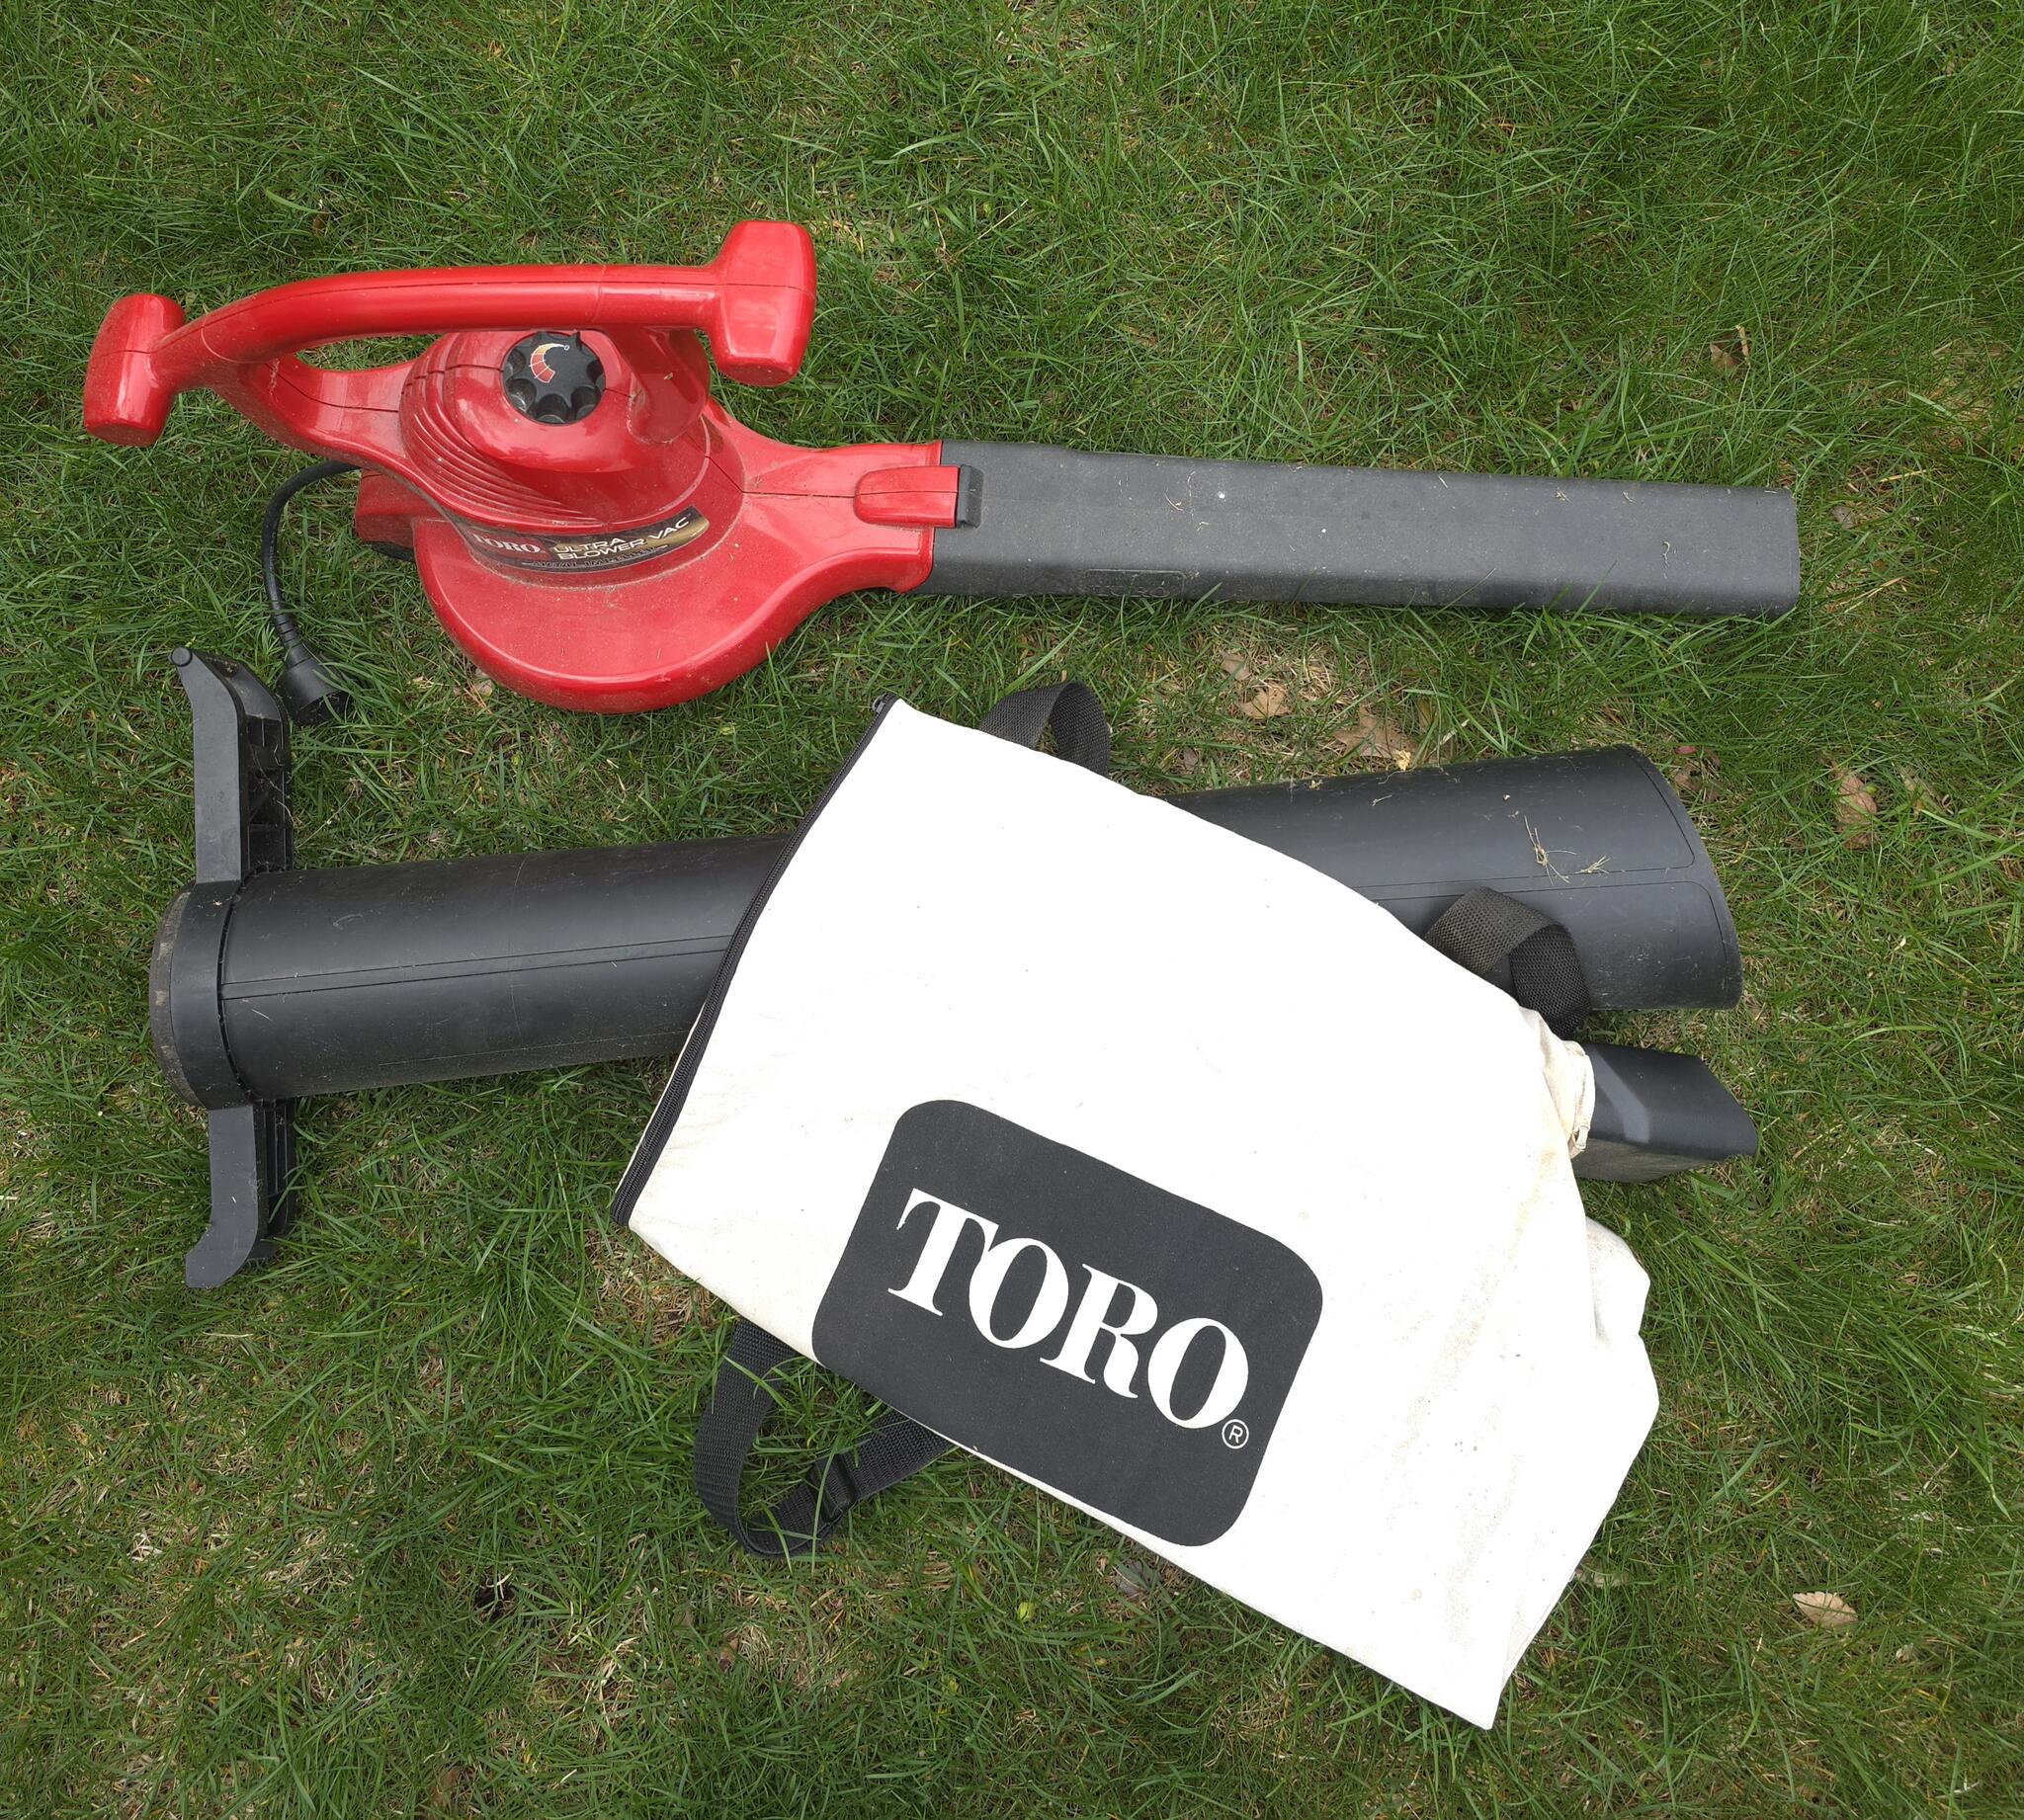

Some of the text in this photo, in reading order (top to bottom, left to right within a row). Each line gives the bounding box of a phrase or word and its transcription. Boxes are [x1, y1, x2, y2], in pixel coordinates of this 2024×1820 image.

[471, 533, 542, 554] TORO
[553, 538, 627, 553] ULTRA
[557, 538, 647, 560] BLOWER
[648, 516, 690, 540] VAC
[887, 1188, 1249, 1430] TORO
